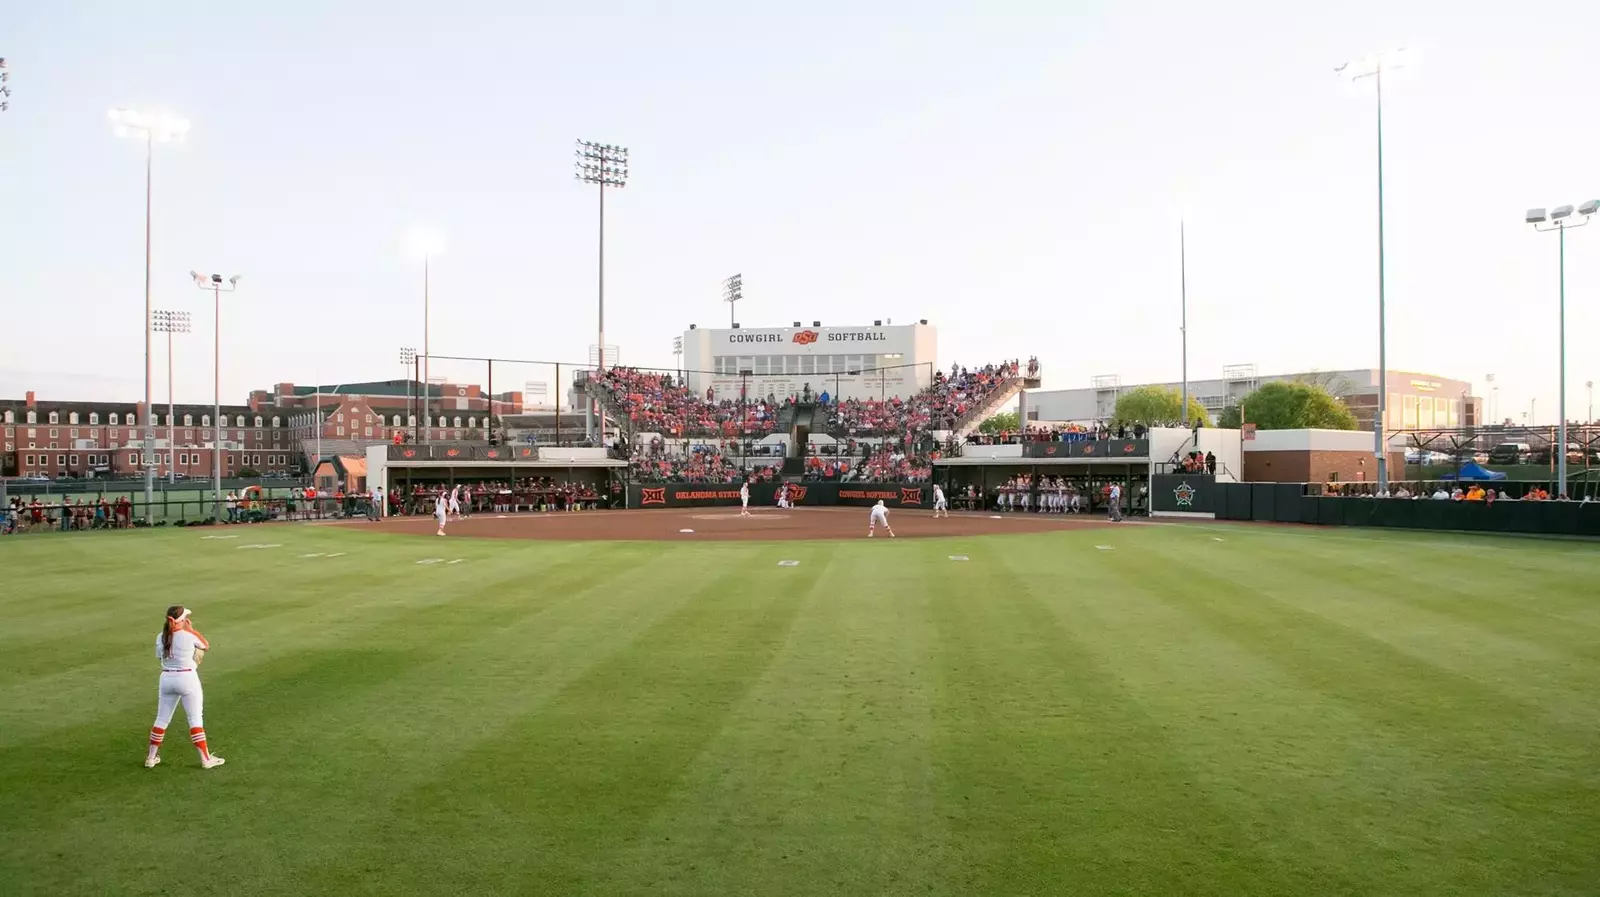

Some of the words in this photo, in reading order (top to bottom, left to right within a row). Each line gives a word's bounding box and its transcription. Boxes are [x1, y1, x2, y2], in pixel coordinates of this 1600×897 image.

[729, 334, 783, 343] COWGIRL
[792, 330, 819, 345] OSU
[828, 332, 886, 341] SOFTBALL
[641, 487, 665, 504] XII
[675, 491, 717, 499] OKLAHOMA
[901, 487, 921, 504] XII
